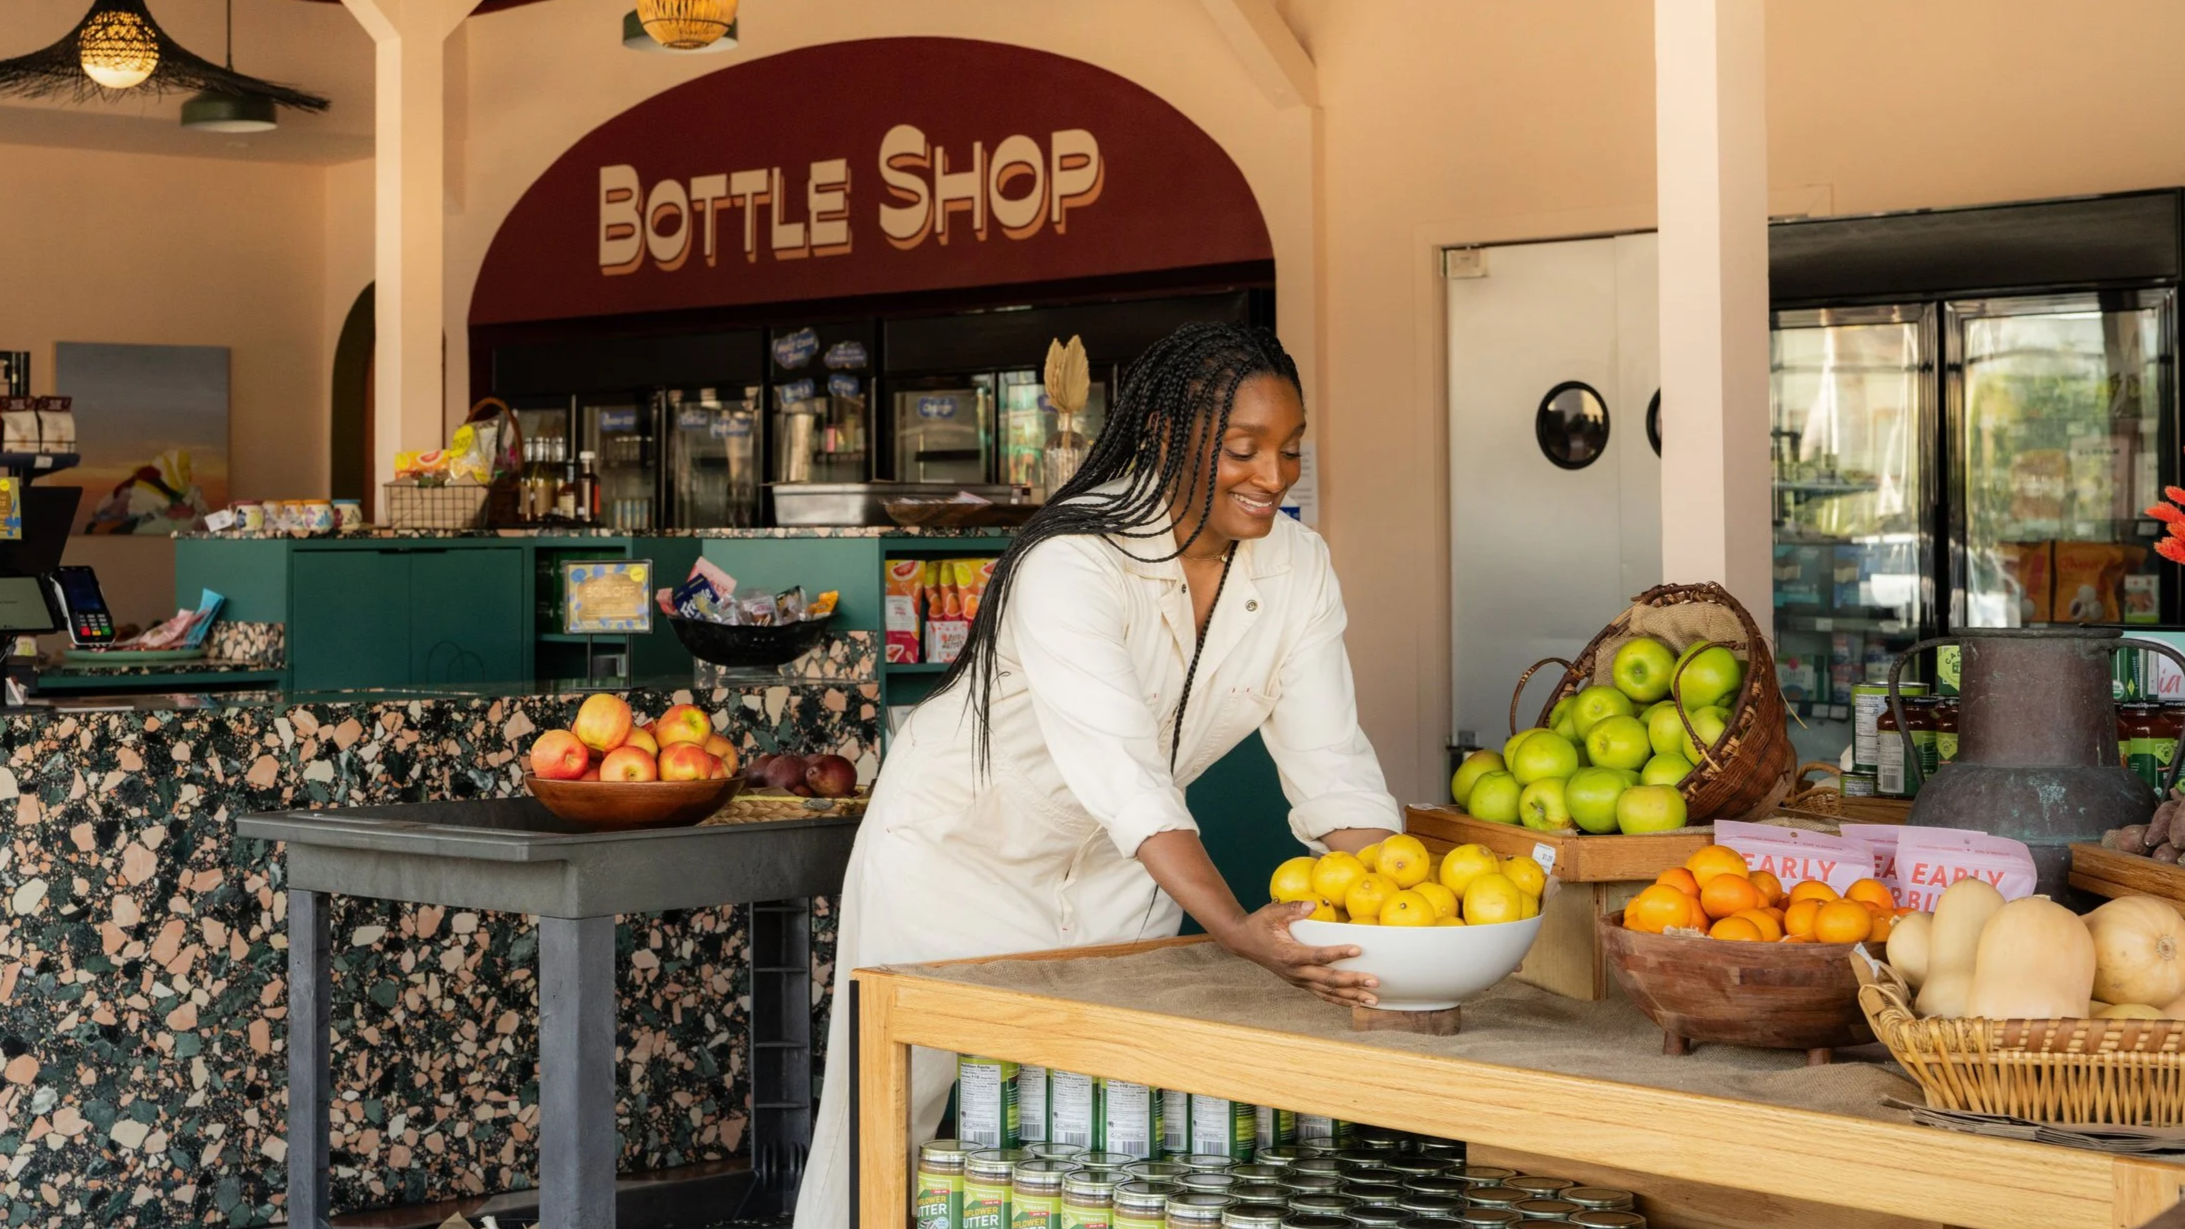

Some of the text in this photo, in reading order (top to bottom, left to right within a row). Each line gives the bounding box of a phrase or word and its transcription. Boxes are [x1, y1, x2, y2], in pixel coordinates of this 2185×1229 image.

[878, 123, 1106, 251] SHOP
[612, 584, 636, 598] OFF
[1740, 852, 1838, 883] EARLY
[1873, 855, 1898, 880] EA
[1908, 890, 1935, 913] BI
[962, 1214, 999, 1229] UTTER
